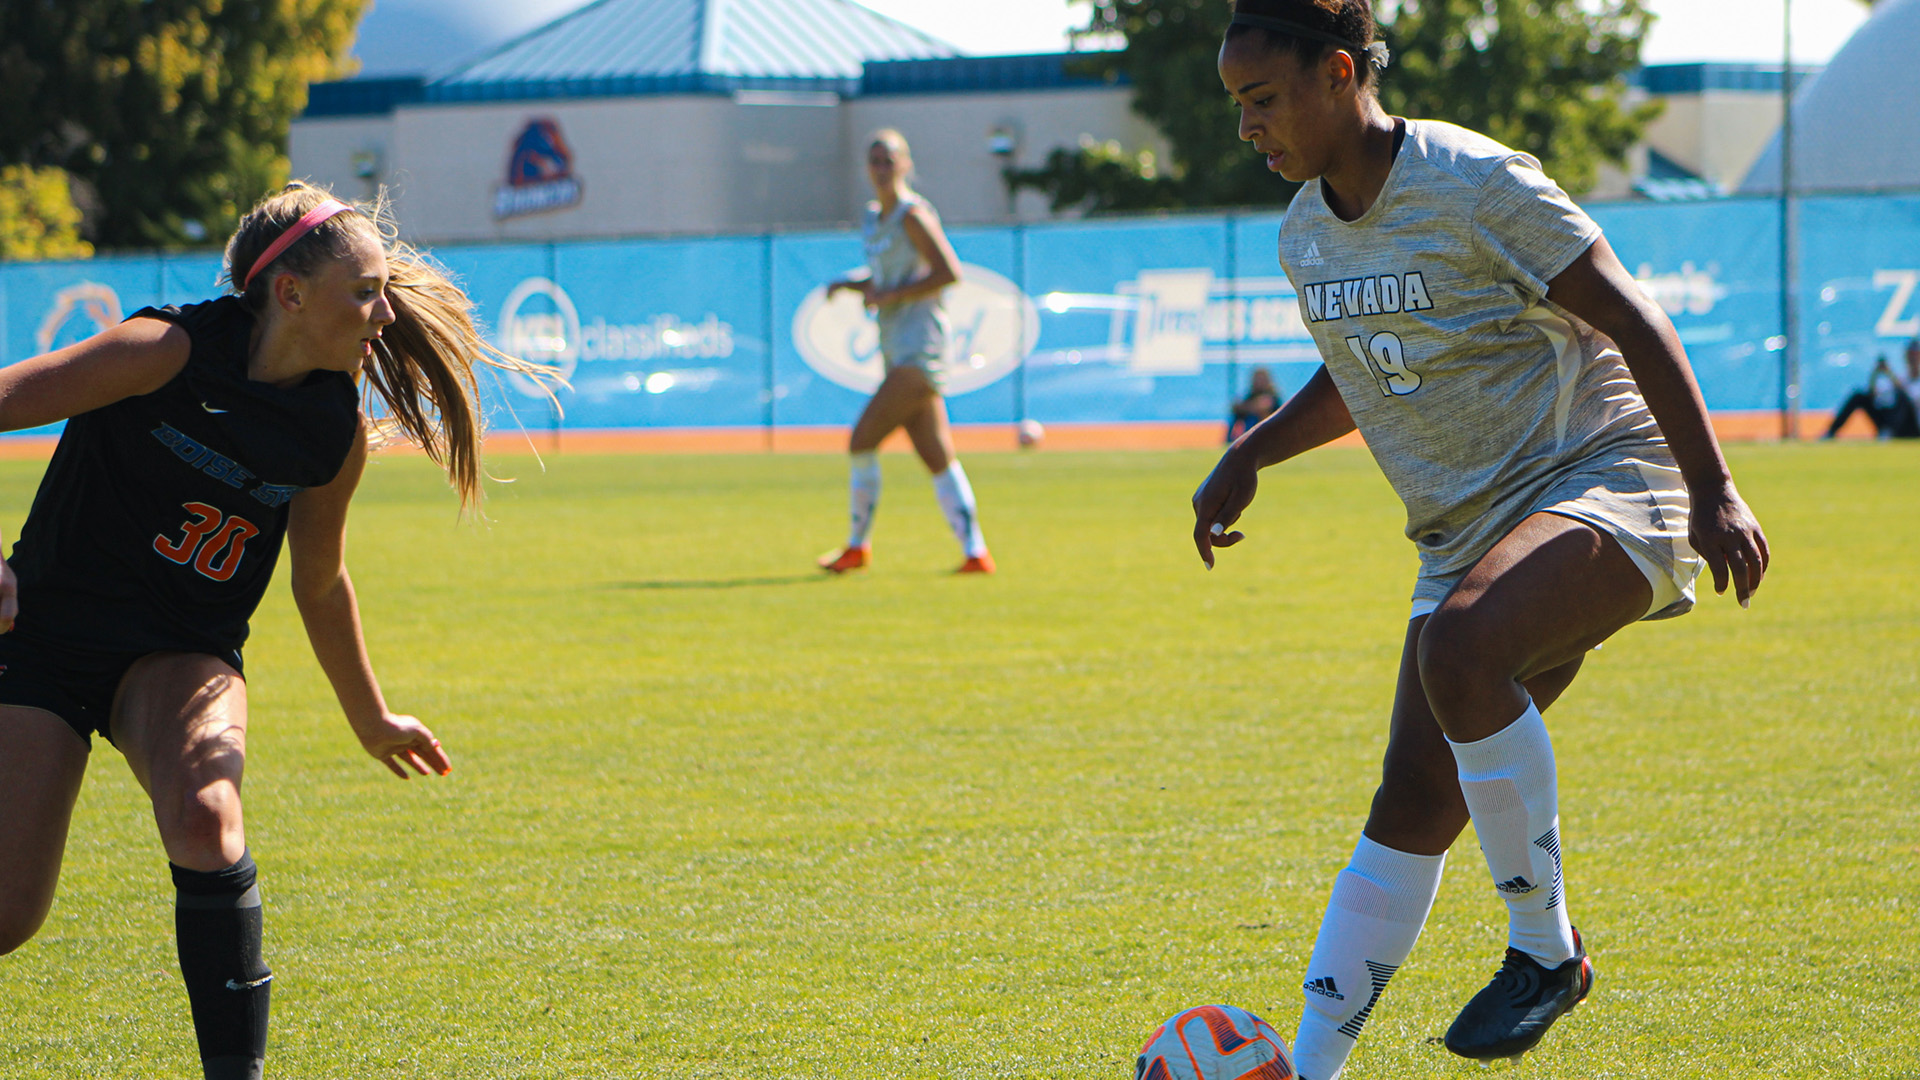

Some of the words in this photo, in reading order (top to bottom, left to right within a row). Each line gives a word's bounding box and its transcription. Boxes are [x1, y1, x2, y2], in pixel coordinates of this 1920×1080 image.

[1300, 257, 1325, 268] adidas
[1304, 270, 1434, 323] NEVADA
[1345, 330, 1422, 397] 19
[151, 421, 256, 489] BOISE
[153, 502, 260, 581] 30
[1303, 982, 1345, 1001] adidas
